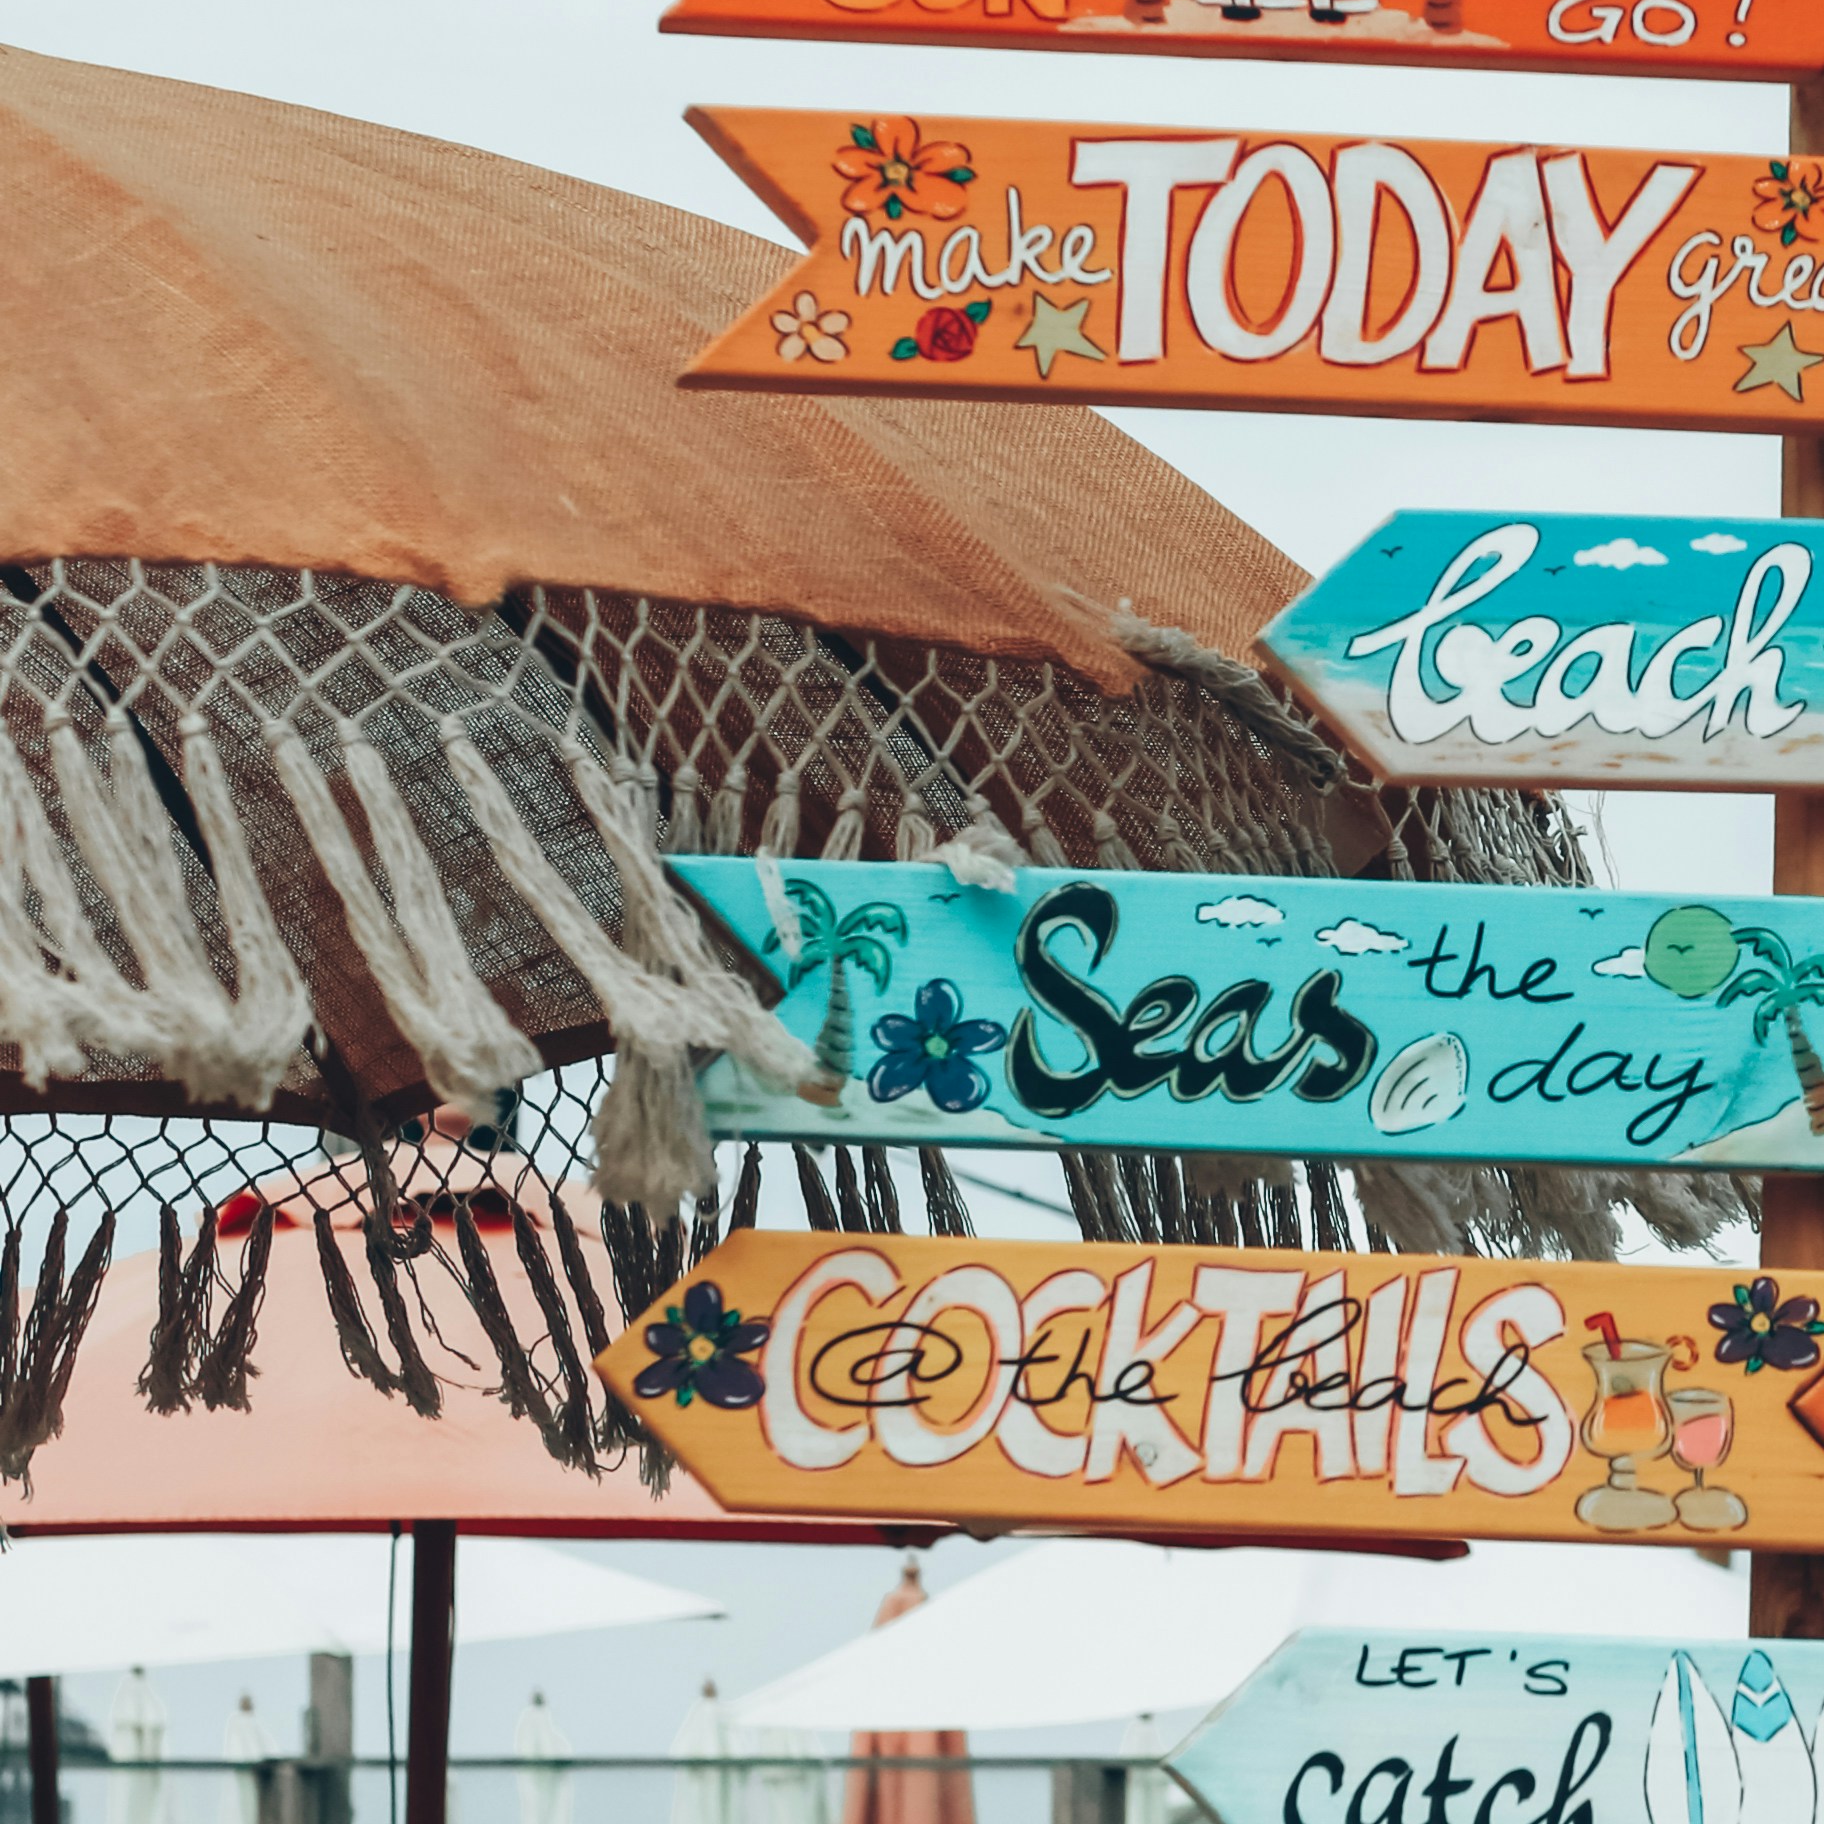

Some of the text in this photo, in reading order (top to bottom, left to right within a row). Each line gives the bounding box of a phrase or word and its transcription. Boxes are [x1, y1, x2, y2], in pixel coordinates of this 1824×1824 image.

[843, 185, 1110, 302] make
[1071, 137, 1707, 381] TODAY
[1346, 521, 1809, 746] beach
[1003, 881, 1380, 1121] Seas
[1407, 920, 1575, 1004] the
[1485, 1036, 1717, 1148] day
[759, 1246, 1577, 1499] COCKTAILS
[808, 1298, 1552, 1427] @ the beach
[1353, 1642, 1570, 1700] LET'S
